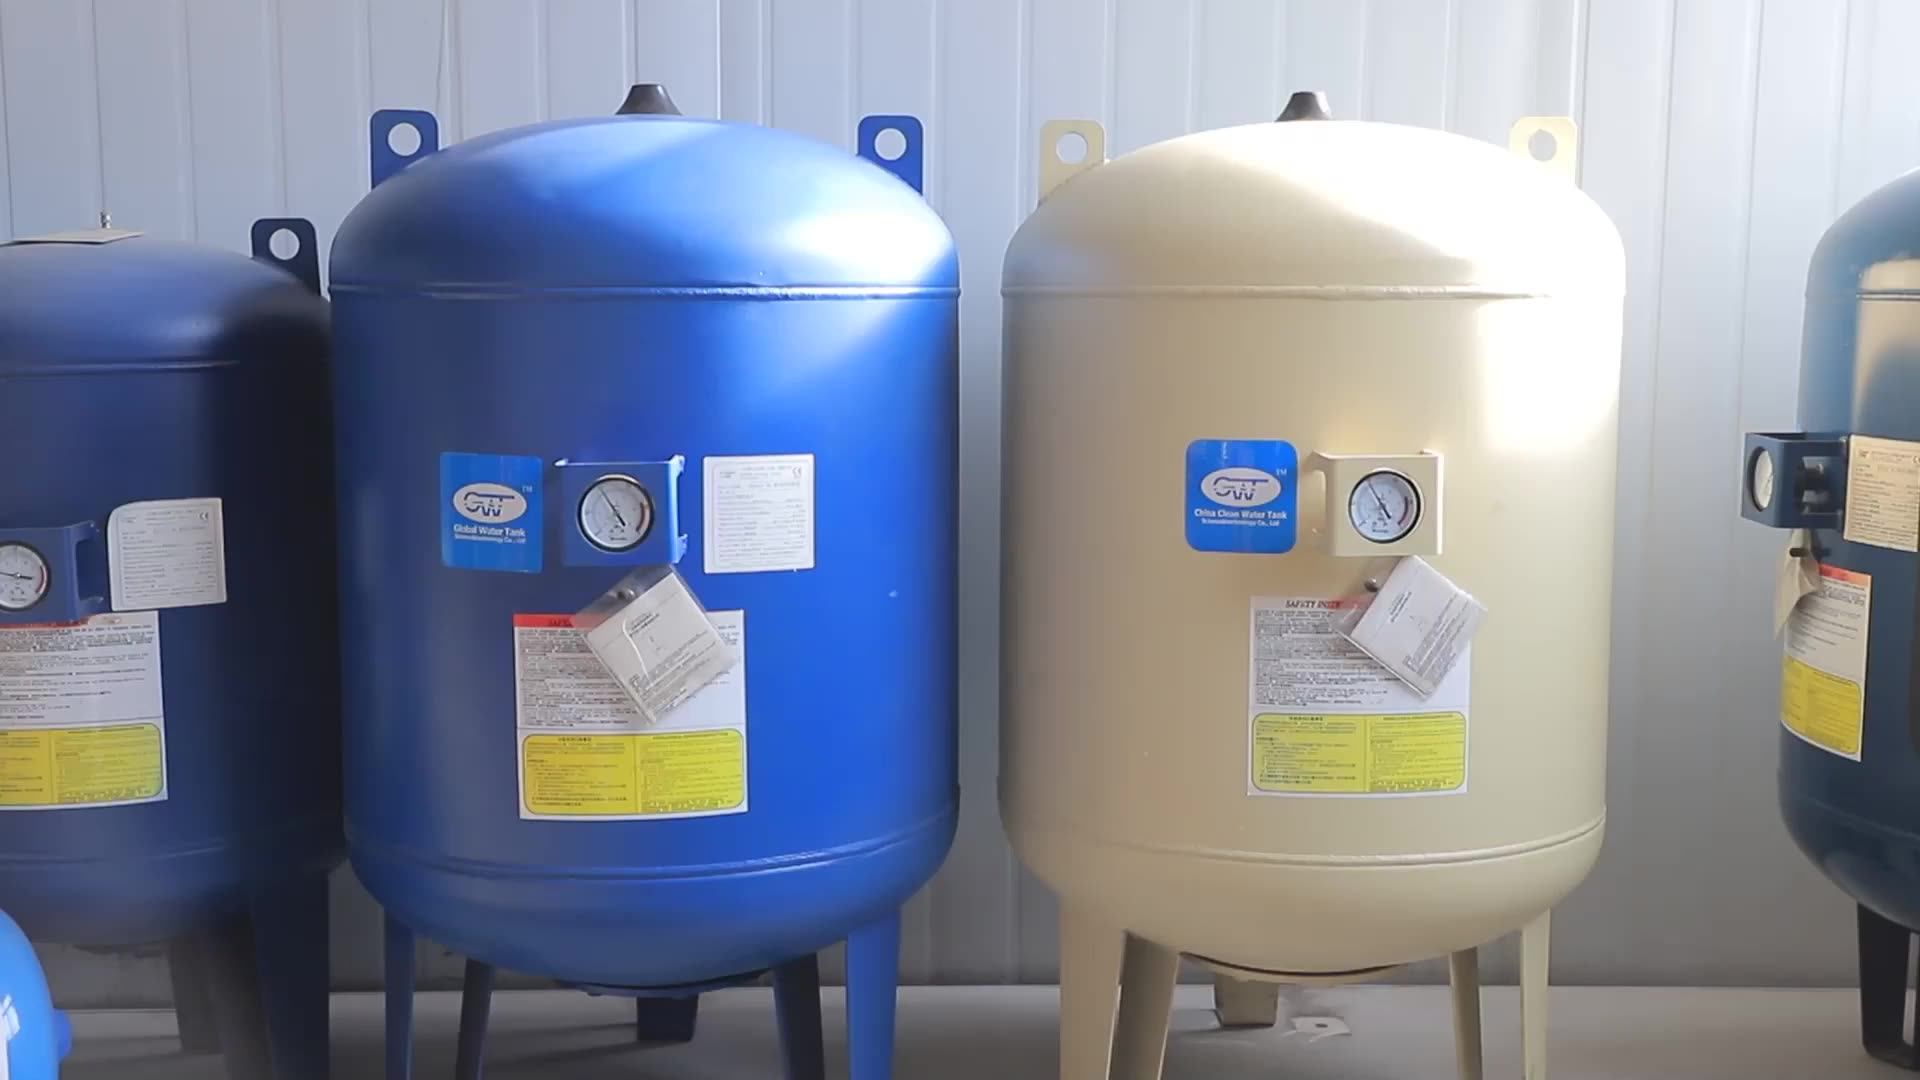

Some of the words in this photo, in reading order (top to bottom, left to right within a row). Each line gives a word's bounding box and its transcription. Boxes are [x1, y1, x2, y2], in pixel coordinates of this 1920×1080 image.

[1194, 507, 1216, 517] China
[1217, 509, 1240, 518] Clean
[1241, 510, 1265, 519] Water
[1266, 510, 1287, 519] Tank
[454, 524, 477, 534] Global
[479, 526, 503, 536] Water
[504, 527, 526, 537] Tank
